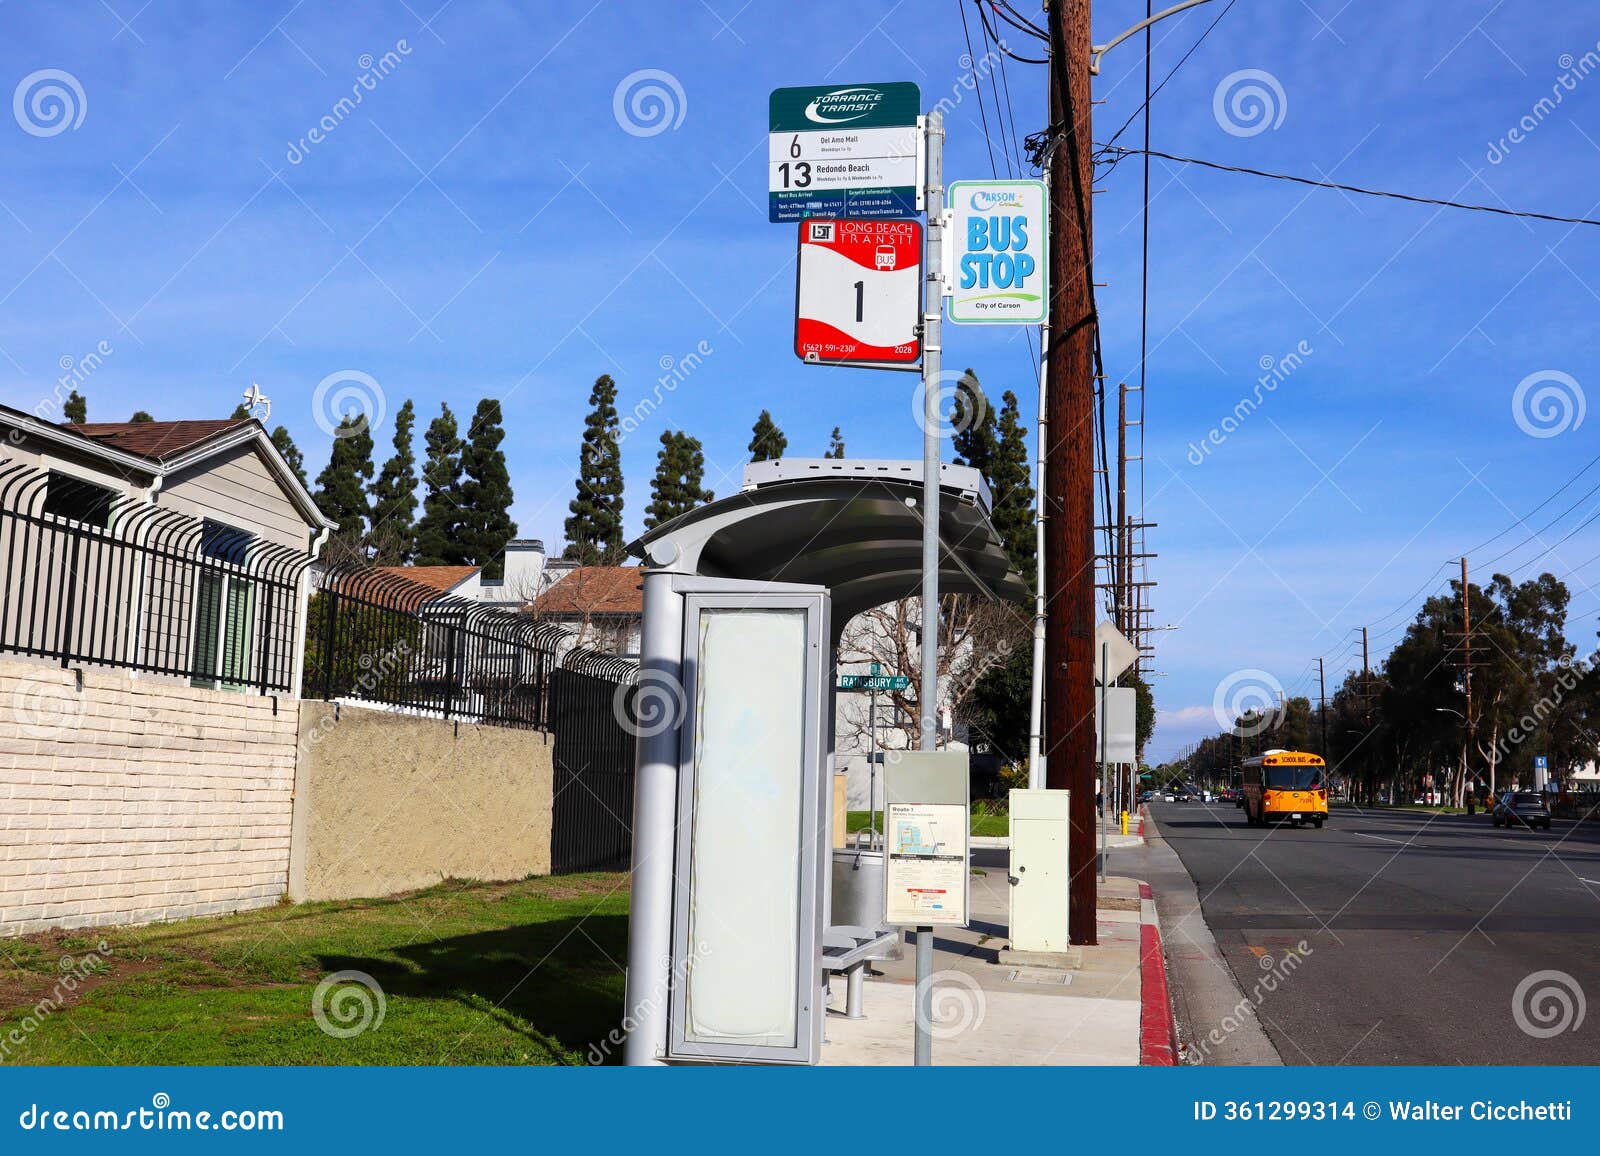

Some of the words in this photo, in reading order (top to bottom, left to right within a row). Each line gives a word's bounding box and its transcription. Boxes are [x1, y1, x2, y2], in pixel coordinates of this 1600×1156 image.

[814, 93, 884, 104] TORRANCE
[821, 103, 878, 113] TRANSIT
[832, 136, 845, 144] Amo
[790, 134, 801, 159] 6
[816, 165, 847, 173] Redondo
[848, 164, 870, 172] Beach
[778, 162, 812, 188] 13
[970, 191, 1015, 212] CARSON
[839, 222, 873, 233] LONG
[876, 222, 913, 233] BEACH
[967, 215, 1029, 252] BUS
[839, 234, 913, 245] TRANSIT
[876, 255, 895, 264] BUS
[960, 252, 1035, 289] STOP
[854, 280, 864, 322] 1
[975, 302, 989, 310] City
[802, 343, 823, 353] (562)
[894, 346, 913, 354] 2028
